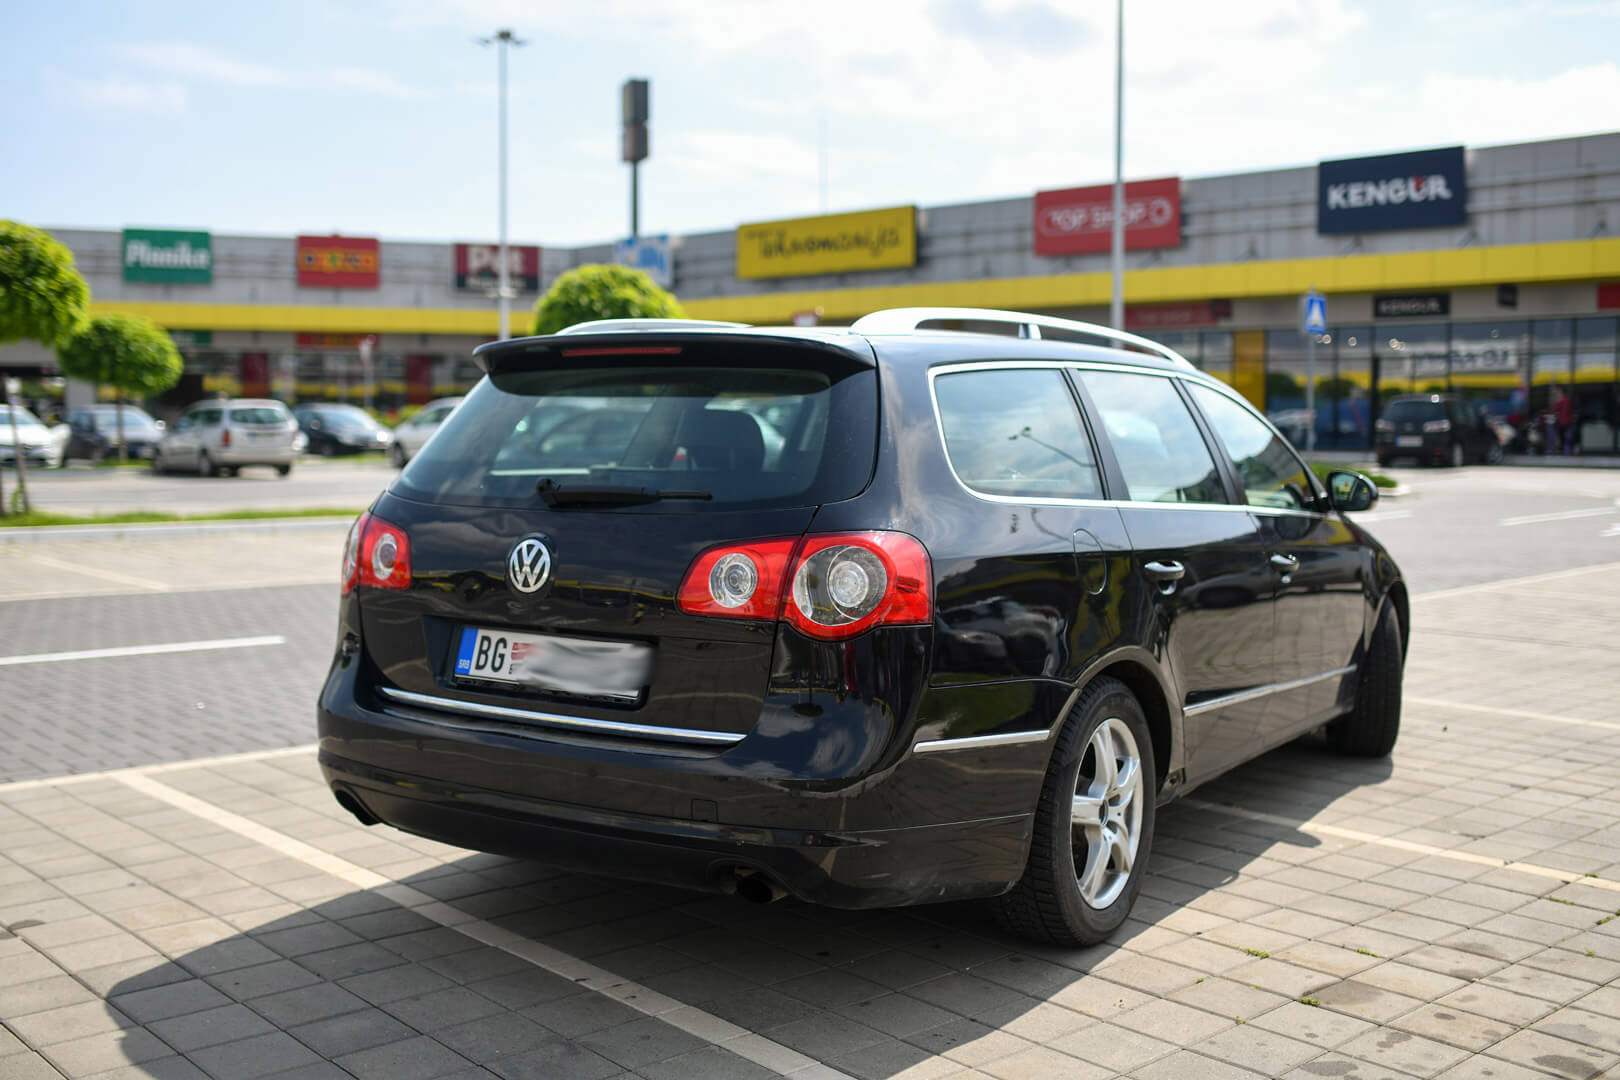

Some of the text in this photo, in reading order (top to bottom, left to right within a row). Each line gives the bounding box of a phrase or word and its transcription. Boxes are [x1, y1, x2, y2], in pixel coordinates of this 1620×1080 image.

[1327, 174, 1452, 210] KENGUR
[1049, 207, 1087, 231] TOP
[125, 239, 210, 268] Planika
[474, 635, 508, 673] BG
